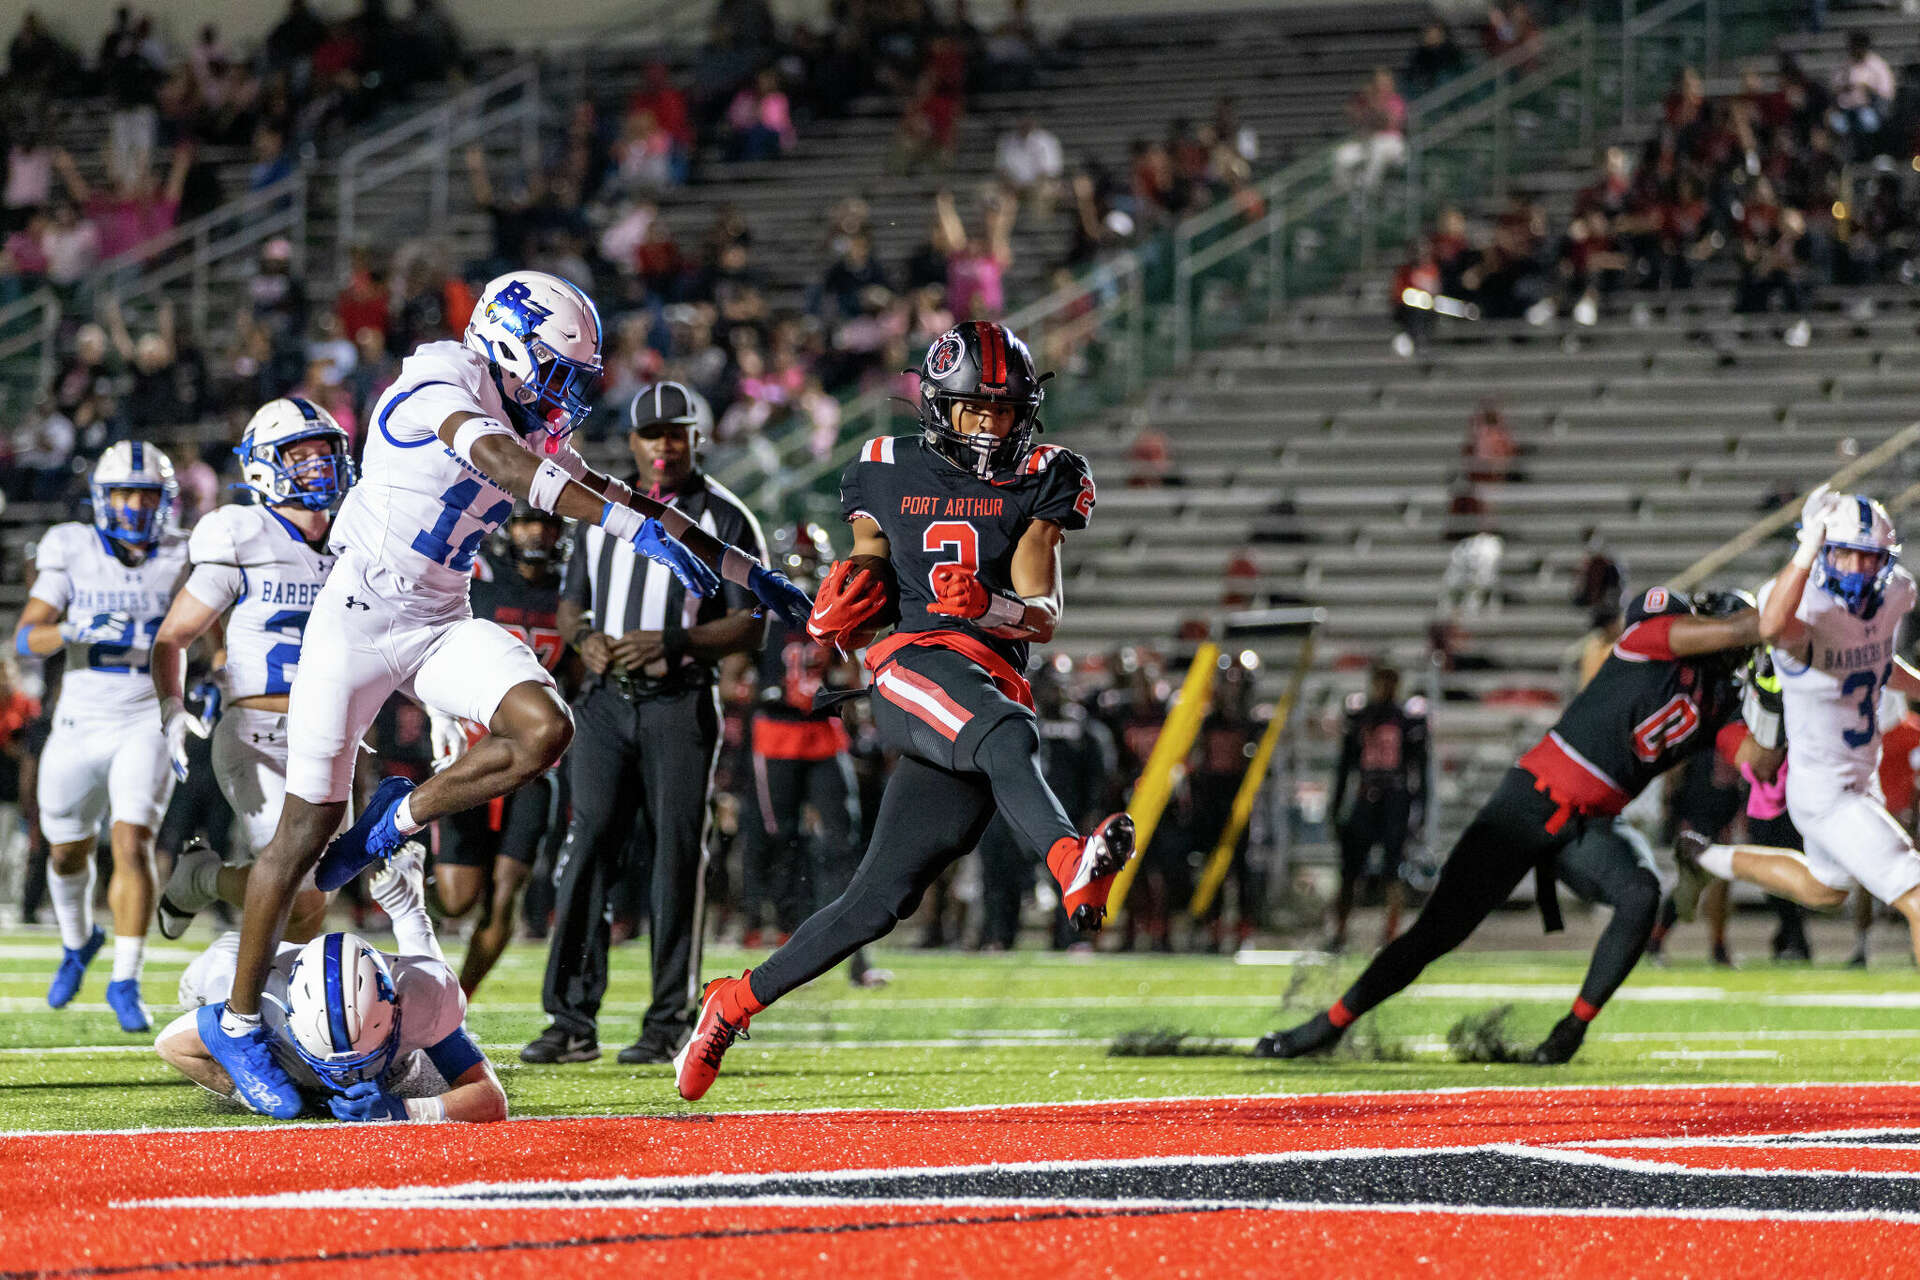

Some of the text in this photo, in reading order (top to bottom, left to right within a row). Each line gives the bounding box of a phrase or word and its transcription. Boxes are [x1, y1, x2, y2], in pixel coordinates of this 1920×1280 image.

[411, 477, 513, 572] 12
[901, 496, 1003, 517] PORT ARTHUR
[262, 580, 324, 606] BARBE
[922, 520, 980, 616] 2
